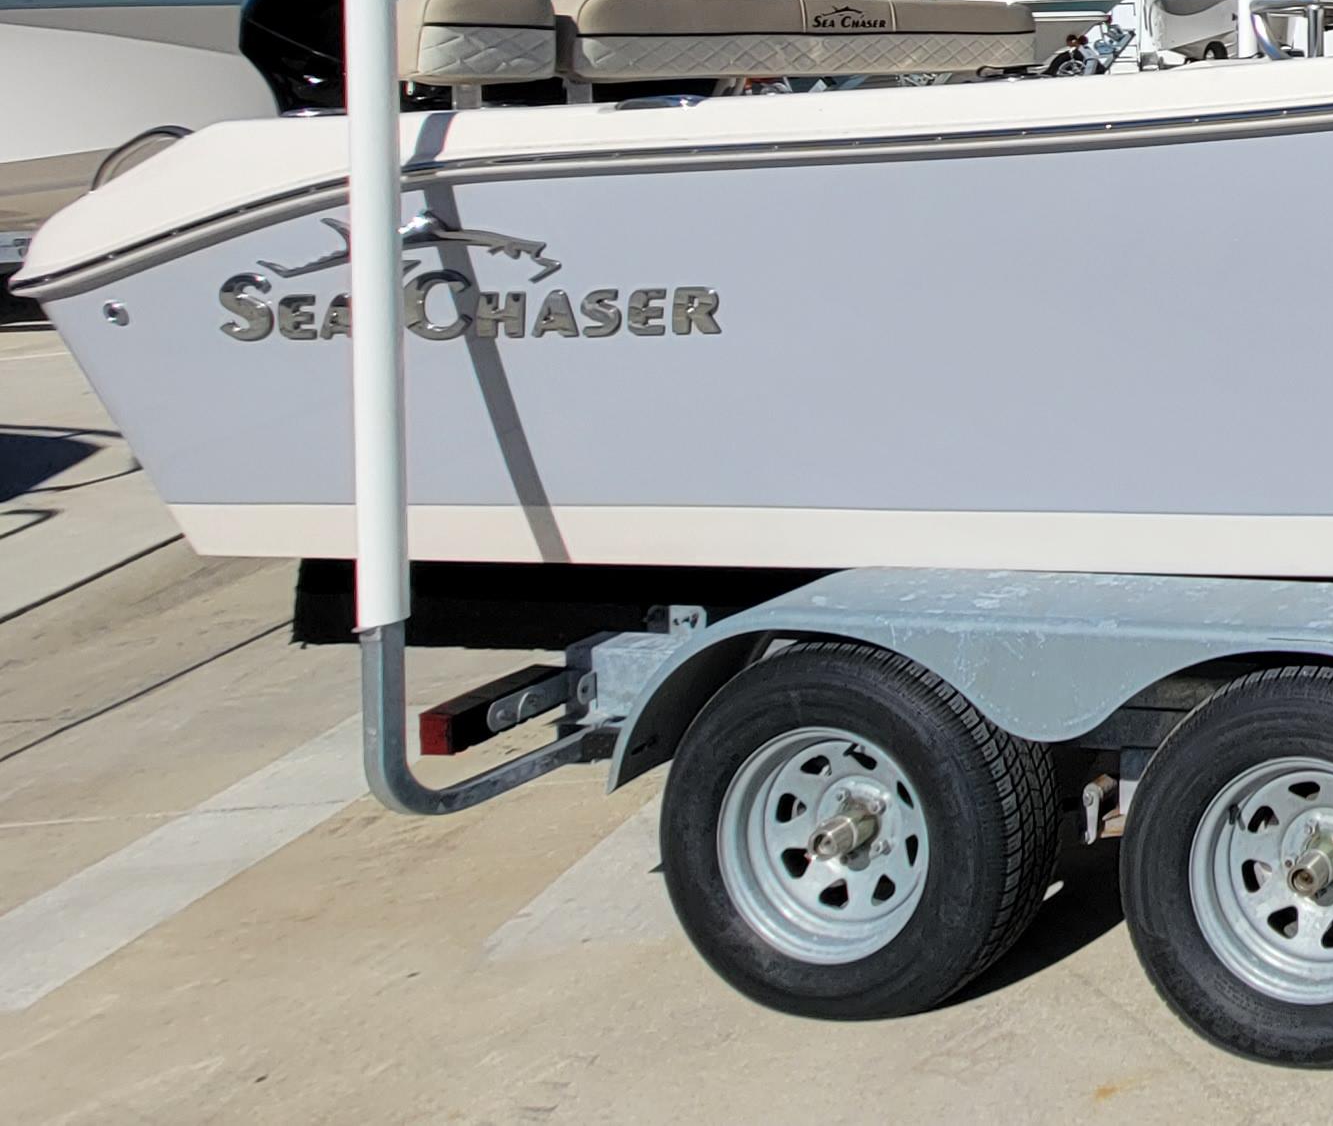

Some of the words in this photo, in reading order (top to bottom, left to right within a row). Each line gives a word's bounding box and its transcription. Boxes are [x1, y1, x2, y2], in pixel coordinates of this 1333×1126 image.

[812, 15, 835, 28] SEA
[840, 15, 886, 28] CHASER
[219, 272, 352, 341] SEA
[403, 269, 722, 342] CHASER
